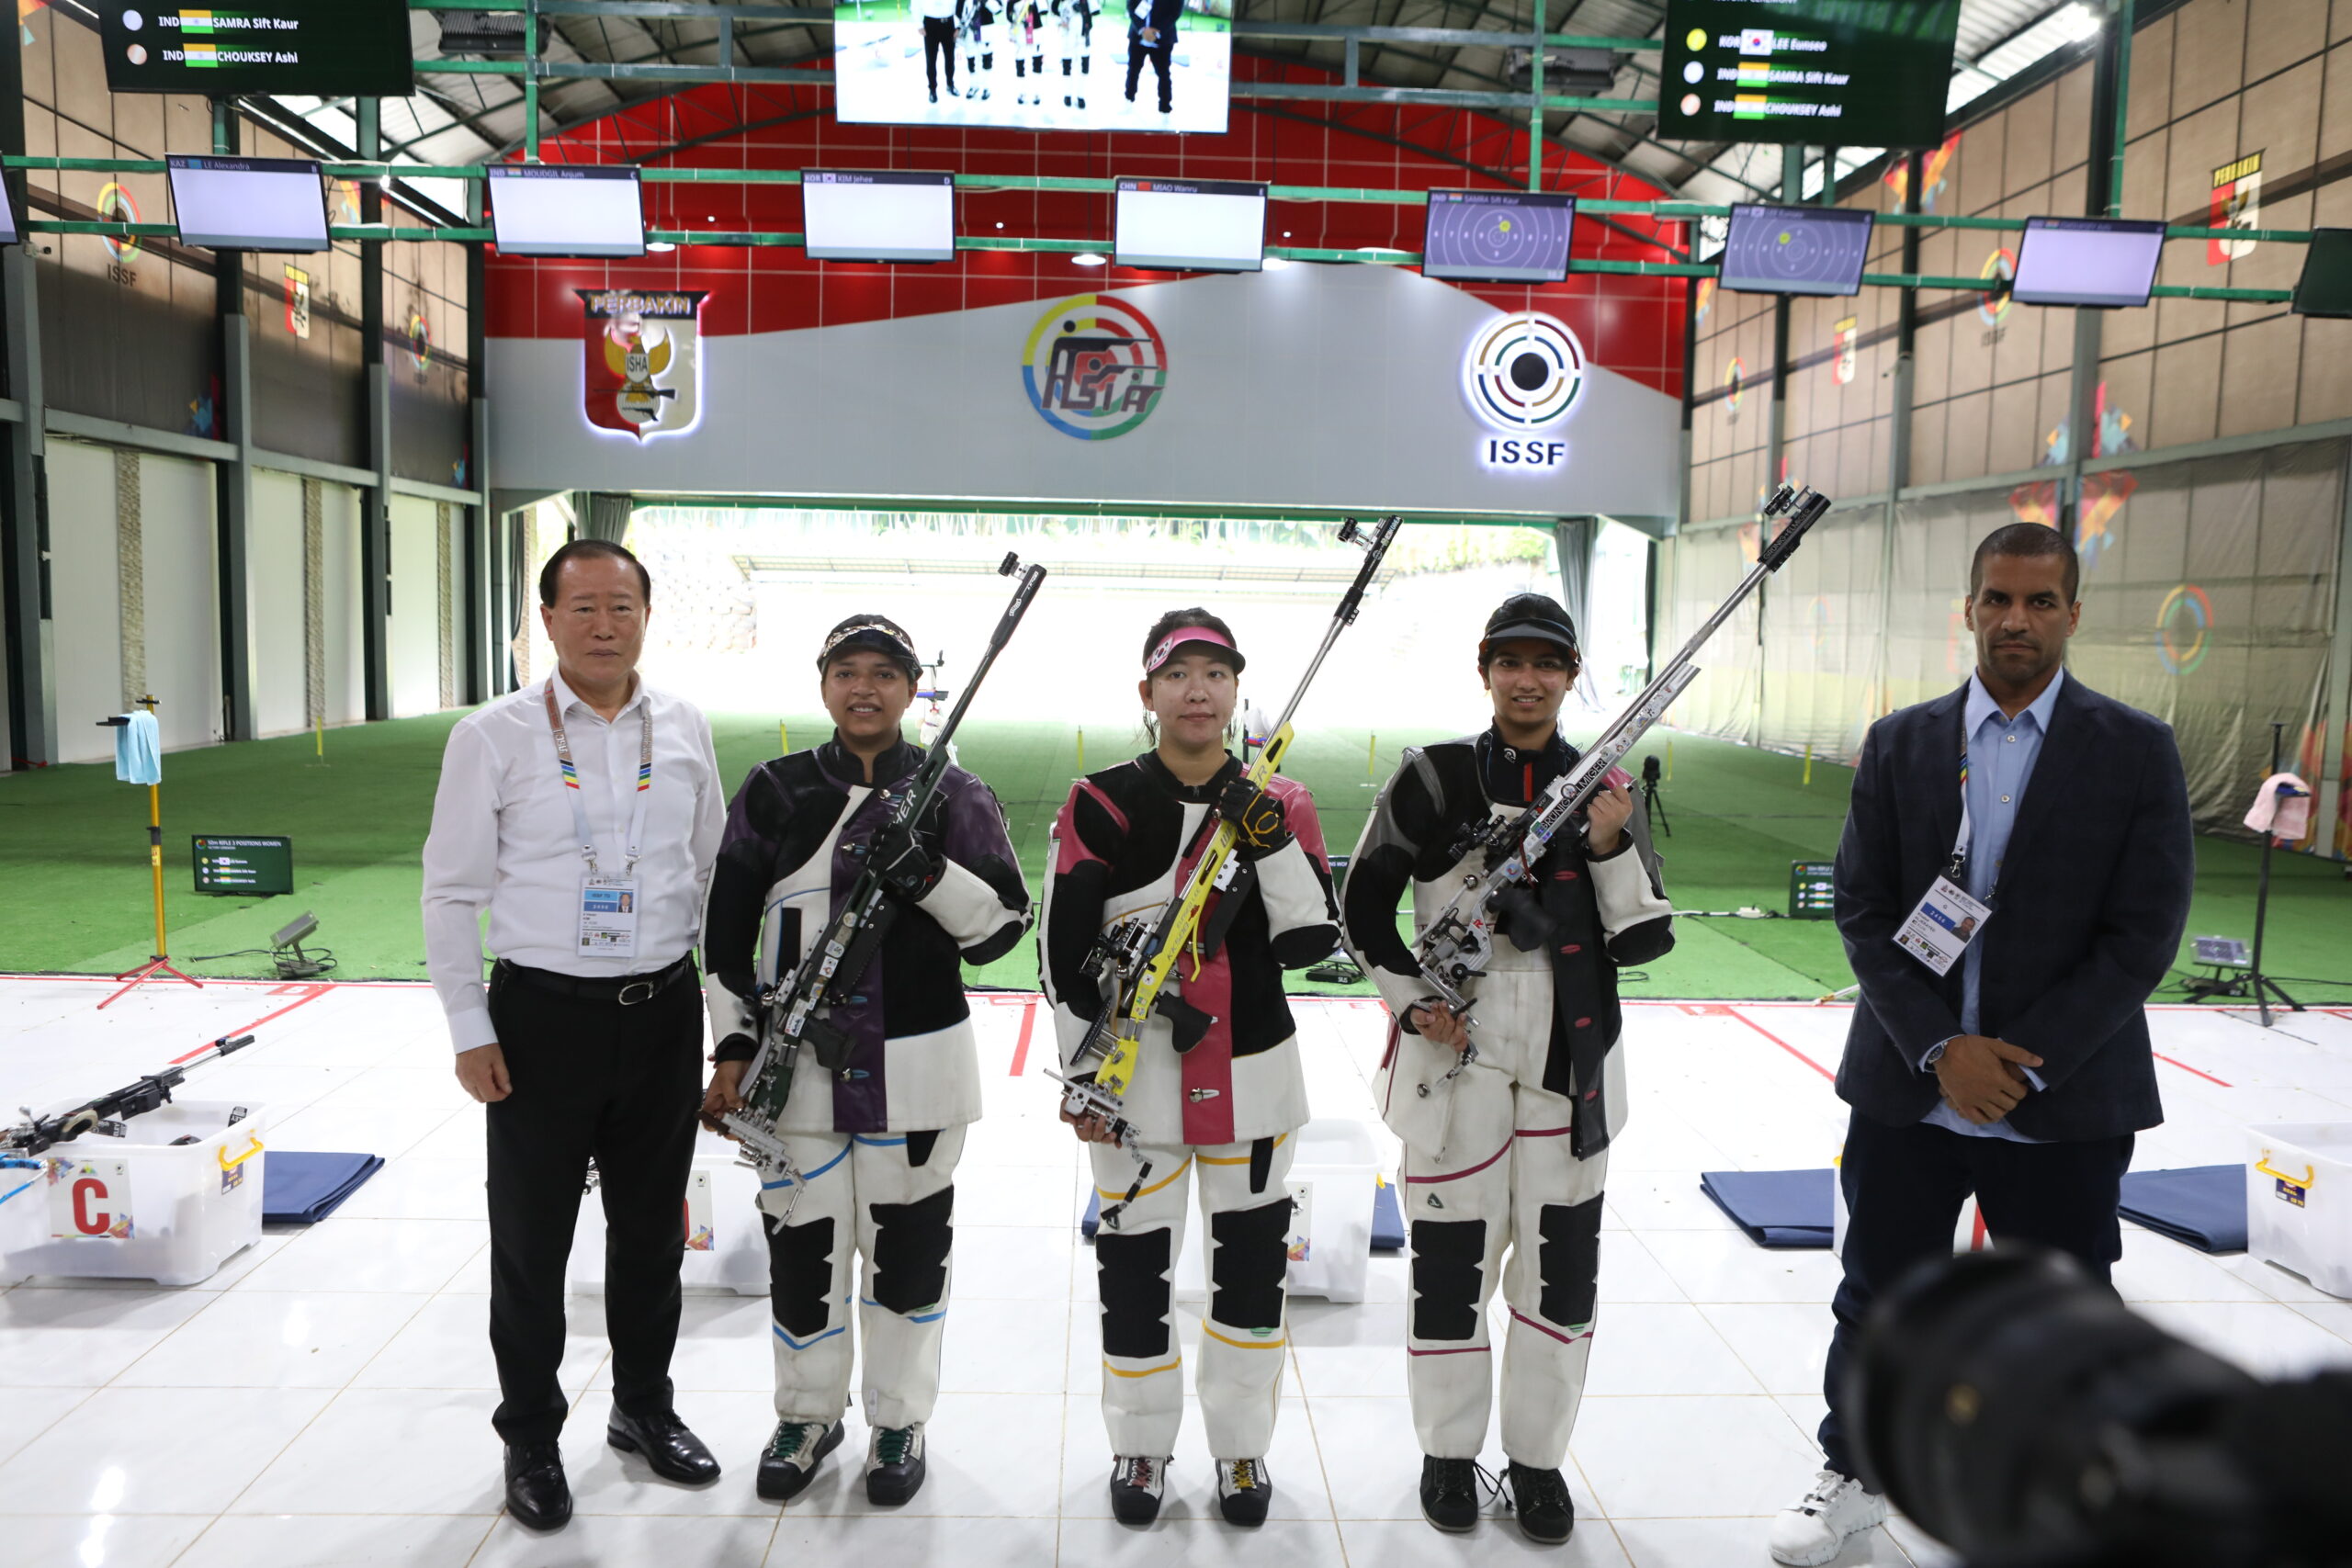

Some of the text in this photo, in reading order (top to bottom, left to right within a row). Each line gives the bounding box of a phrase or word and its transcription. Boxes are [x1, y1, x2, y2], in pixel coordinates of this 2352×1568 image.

[158, 16, 299, 30] IND SAMRA Sift Kaur
[1719, 35, 1827, 51] KOR LEE Eunseo
[163, 50, 299, 64] IND CHOUKSEY Ashi
[1716, 68, 1850, 85] IND SAMRA Sift Kaur
[1713, 100, 1842, 118] IND CHOUKSEY Ashi
[107, 263, 137, 288] ISSF
[591, 294, 691, 315] PERBAKIN
[627, 355, 649, 373] ISHA
[1489, 439, 1566, 466] ISSF
[1576, 757, 1608, 792] LMIGER
[892, 788, 917, 825] HER
[72, 1177, 110, 1235] C
